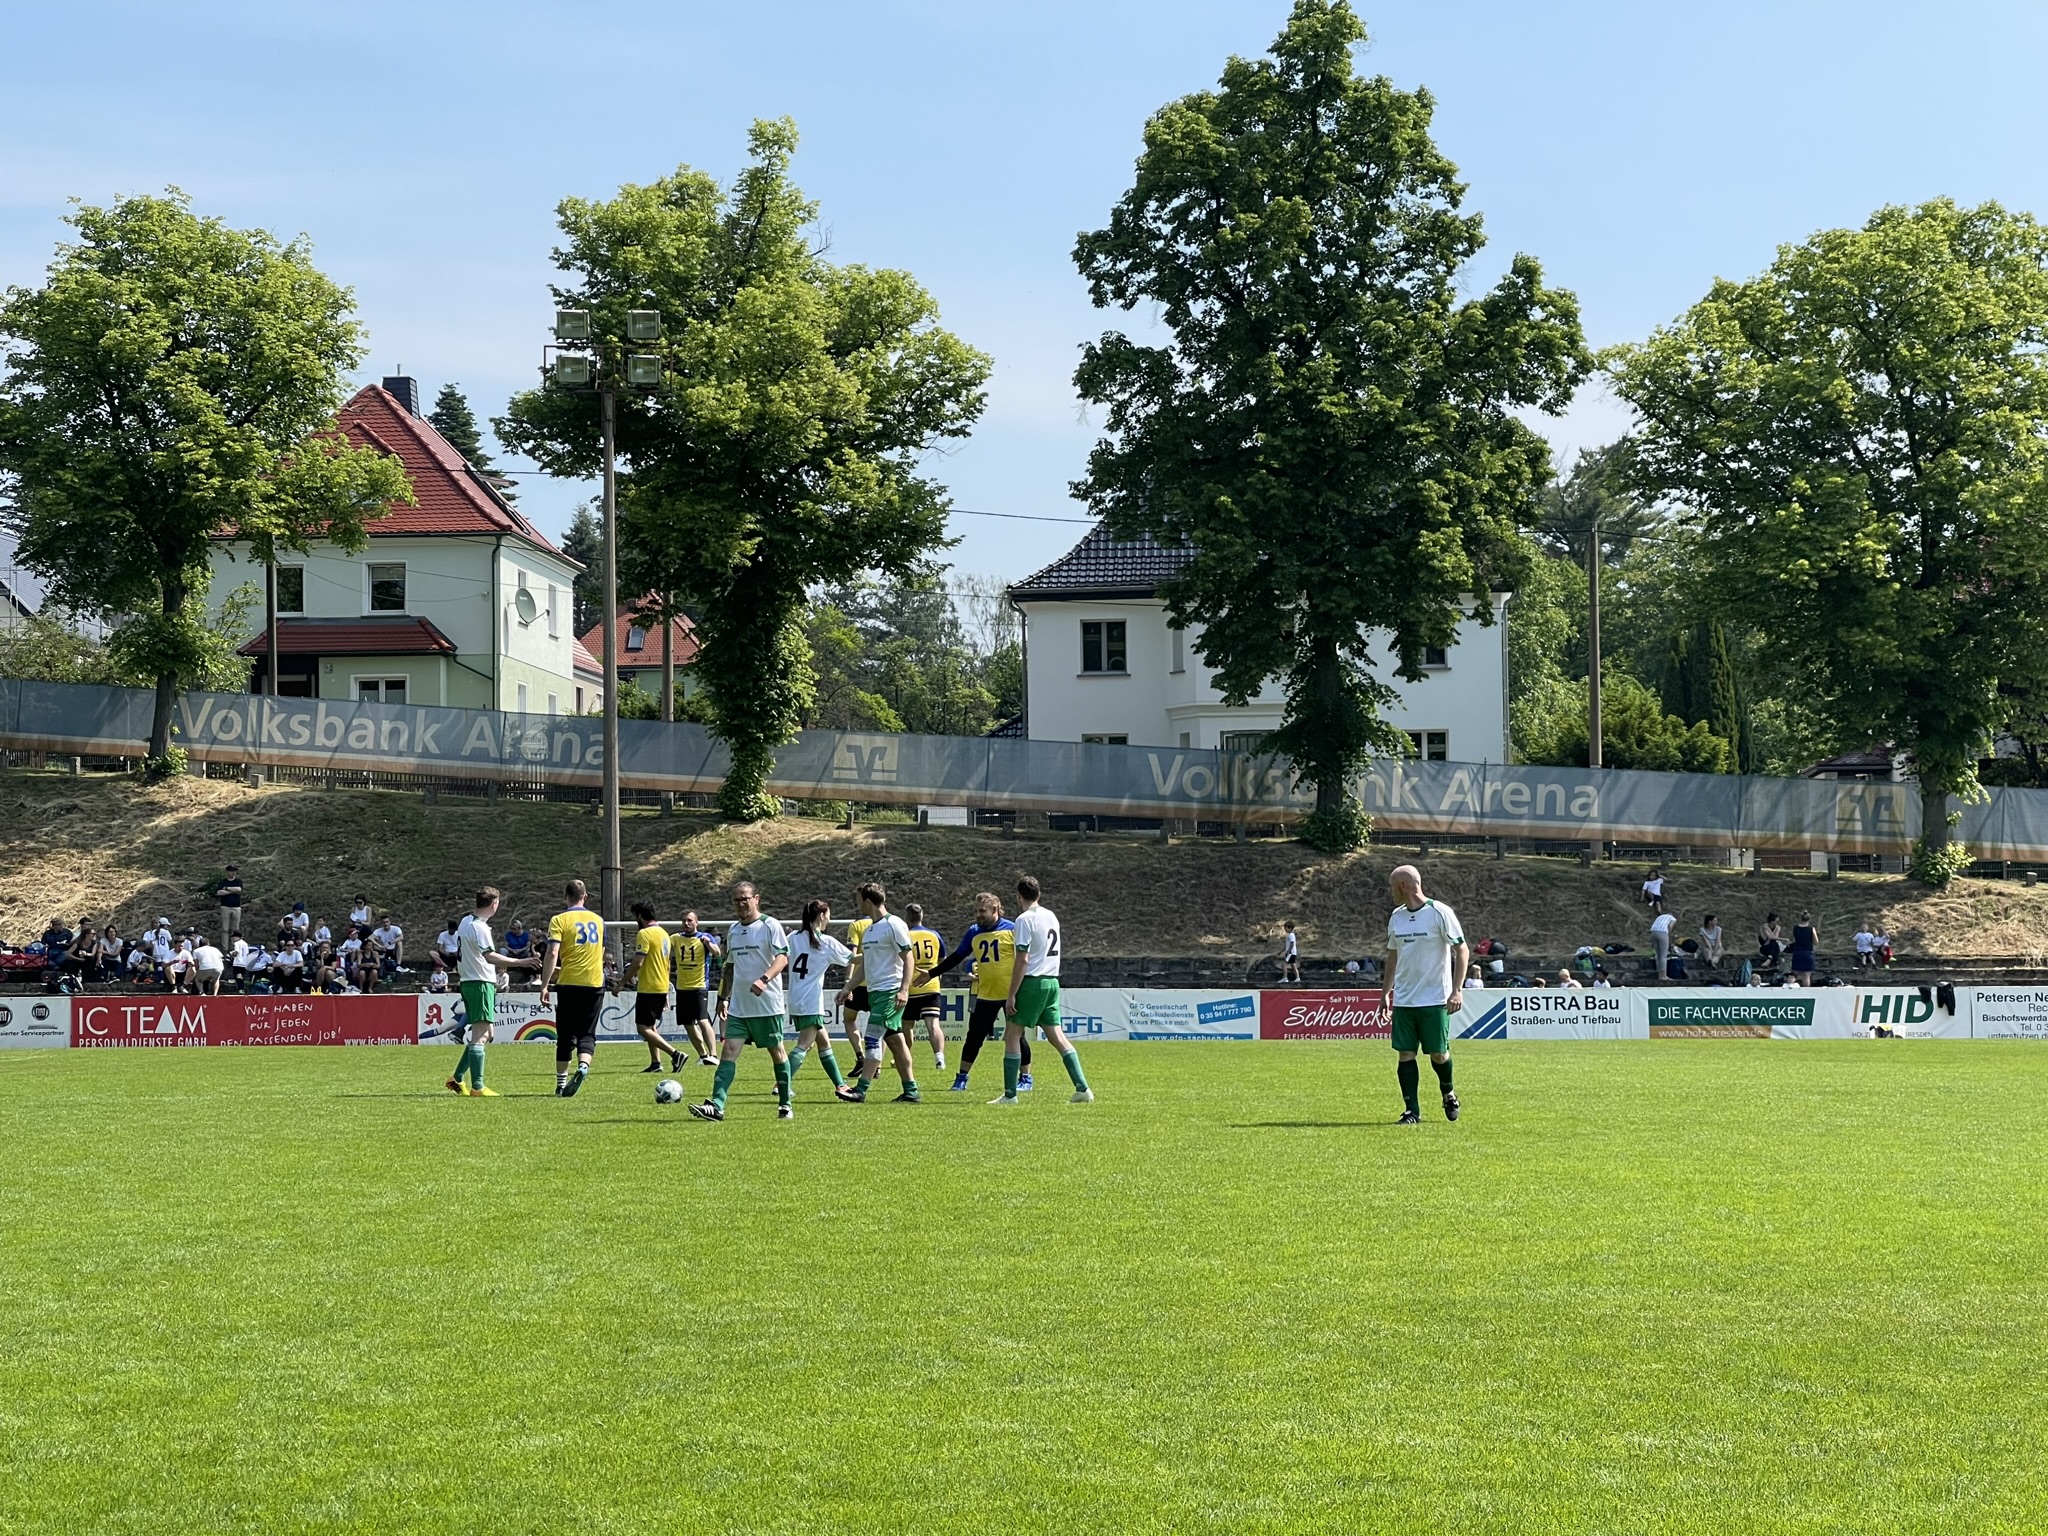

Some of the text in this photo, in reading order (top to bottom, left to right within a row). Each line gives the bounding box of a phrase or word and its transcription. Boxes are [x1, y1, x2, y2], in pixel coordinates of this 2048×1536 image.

[178, 697, 605, 766] Volksbank Arena
[1148, 753, 1599, 818] Volksbnk Arena
[575, 921, 599, 945] 38
[1047, 928, 1059, 957] 2
[680, 945, 695, 961] 11
[914, 940, 933, 960] 15
[979, 939, 1000, 963] 21
[792, 953, 809, 980] 4
[1511, 996, 1620, 1011] BISTRA Bau
[1976, 992, 2031, 1003] Petersen
[1658, 1006, 1806, 1019] DIE FACHVERPACKER
[1861, 995, 1934, 1023] HID
[1982, 1014, 2048, 1022] Bischofswerda
[79, 1005, 207, 1035] IC TEAM
[274, 1018, 310, 1033] JEDEN
[1060, 1017, 1103, 1033] GFG
[1511, 1015, 1621, 1025] Straßen- und Tiefbau
